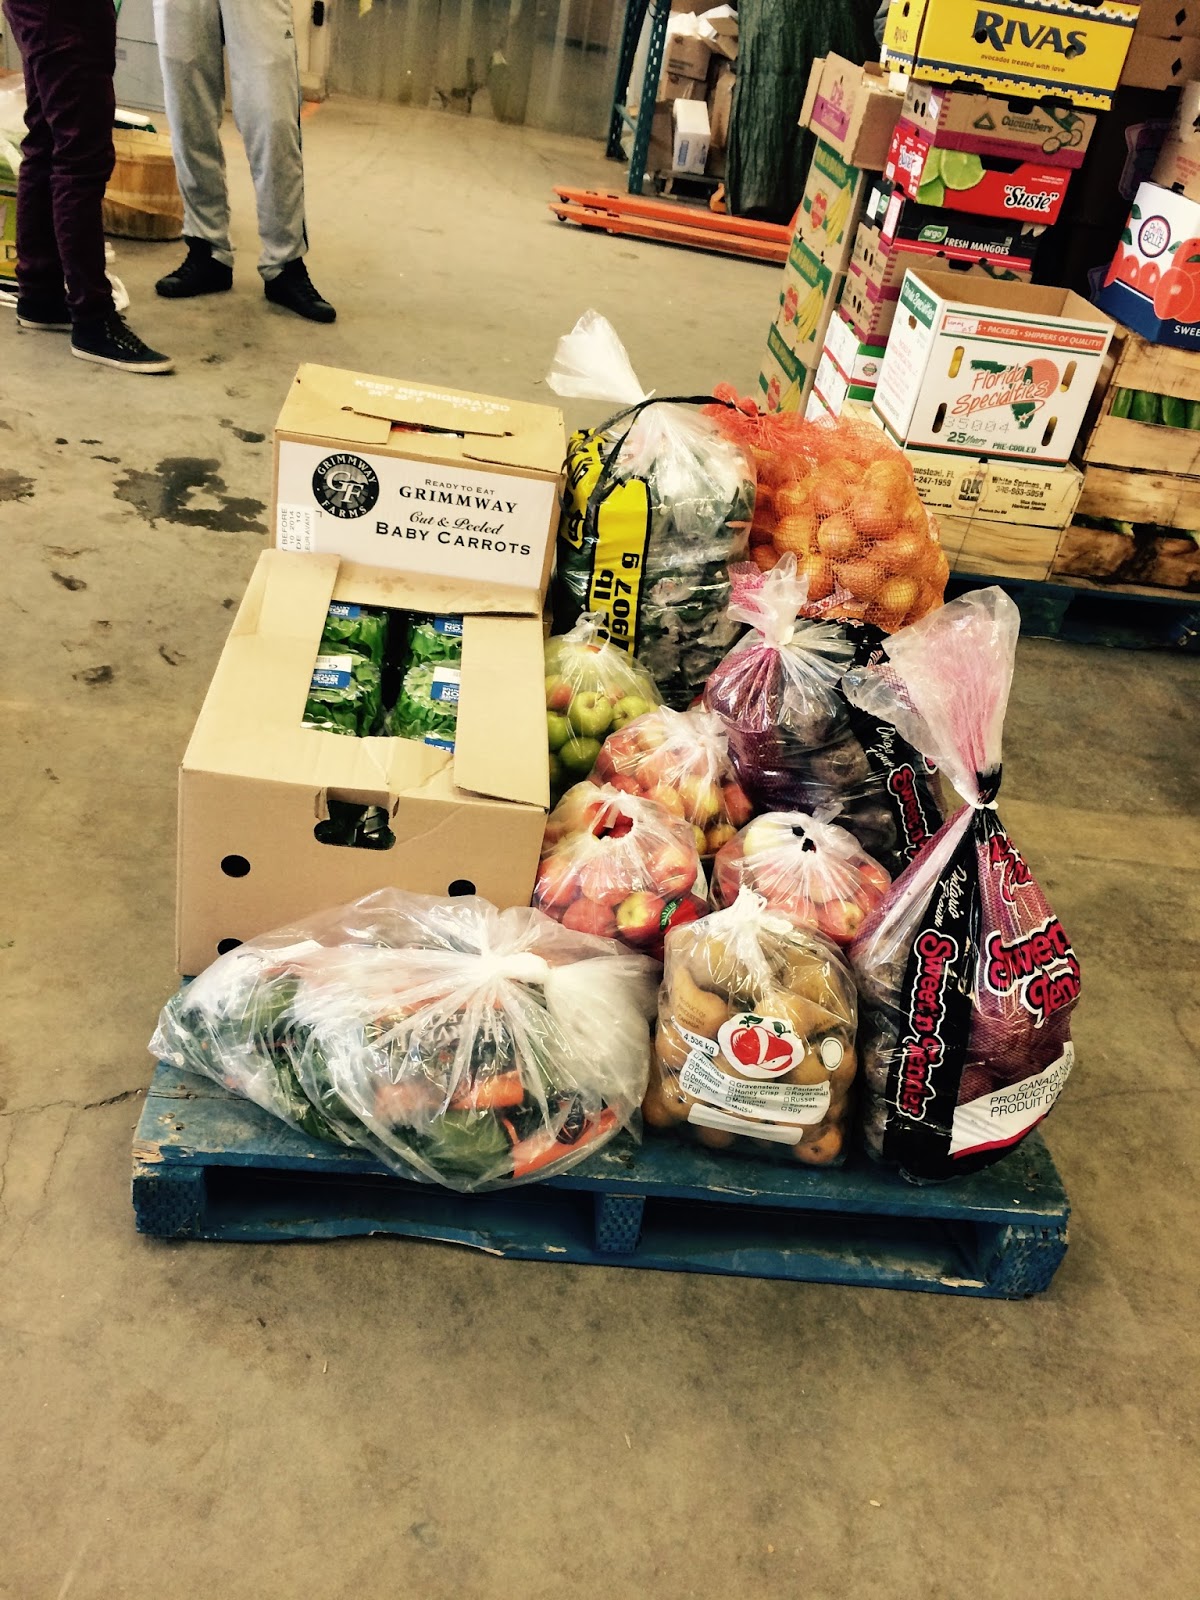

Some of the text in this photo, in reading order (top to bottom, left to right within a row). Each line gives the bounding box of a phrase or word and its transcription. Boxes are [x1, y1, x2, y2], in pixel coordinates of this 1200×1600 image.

[971, 9, 1087, 55] RIVAS
[981, 54, 1065, 73] avocados treated with love
[1001, 115, 1053, 133] Cucumbers
[923, 229, 942, 239] argo
[944, 237, 969, 249] FRESH
[971, 241, 1010, 256] MANGOES
[987, 325, 1018, 337] PACKERS
[1024, 330, 1057, 342] SHIPPERS
[1058, 335, 1068, 343] OF
[972, 363, 1026, 391] Florida
[951, 380, 1049, 417] Specialties
[317, 455, 377, 483] GRIMMWAY
[425, 478, 459, 490] READY
[476, 486, 496, 496] EAT
[959, 477, 981, 495] QK
[322, 500, 367, 518] FARMS
[399, 485, 518, 514] GRIMMWAY
[409, 510, 505, 535] Cut & Peeled
[375, 521, 532, 556] BABY CARROTS
[593, 569, 615, 601] lb
[705, 1042, 715, 1054] kg
[735, 1087, 758, 1096] Honey
[1018, 1070, 1059, 1092] CANADA
[990, 1085, 1047, 1106] PRODUCT
[990, 1096, 1043, 1118] PRODUIT
